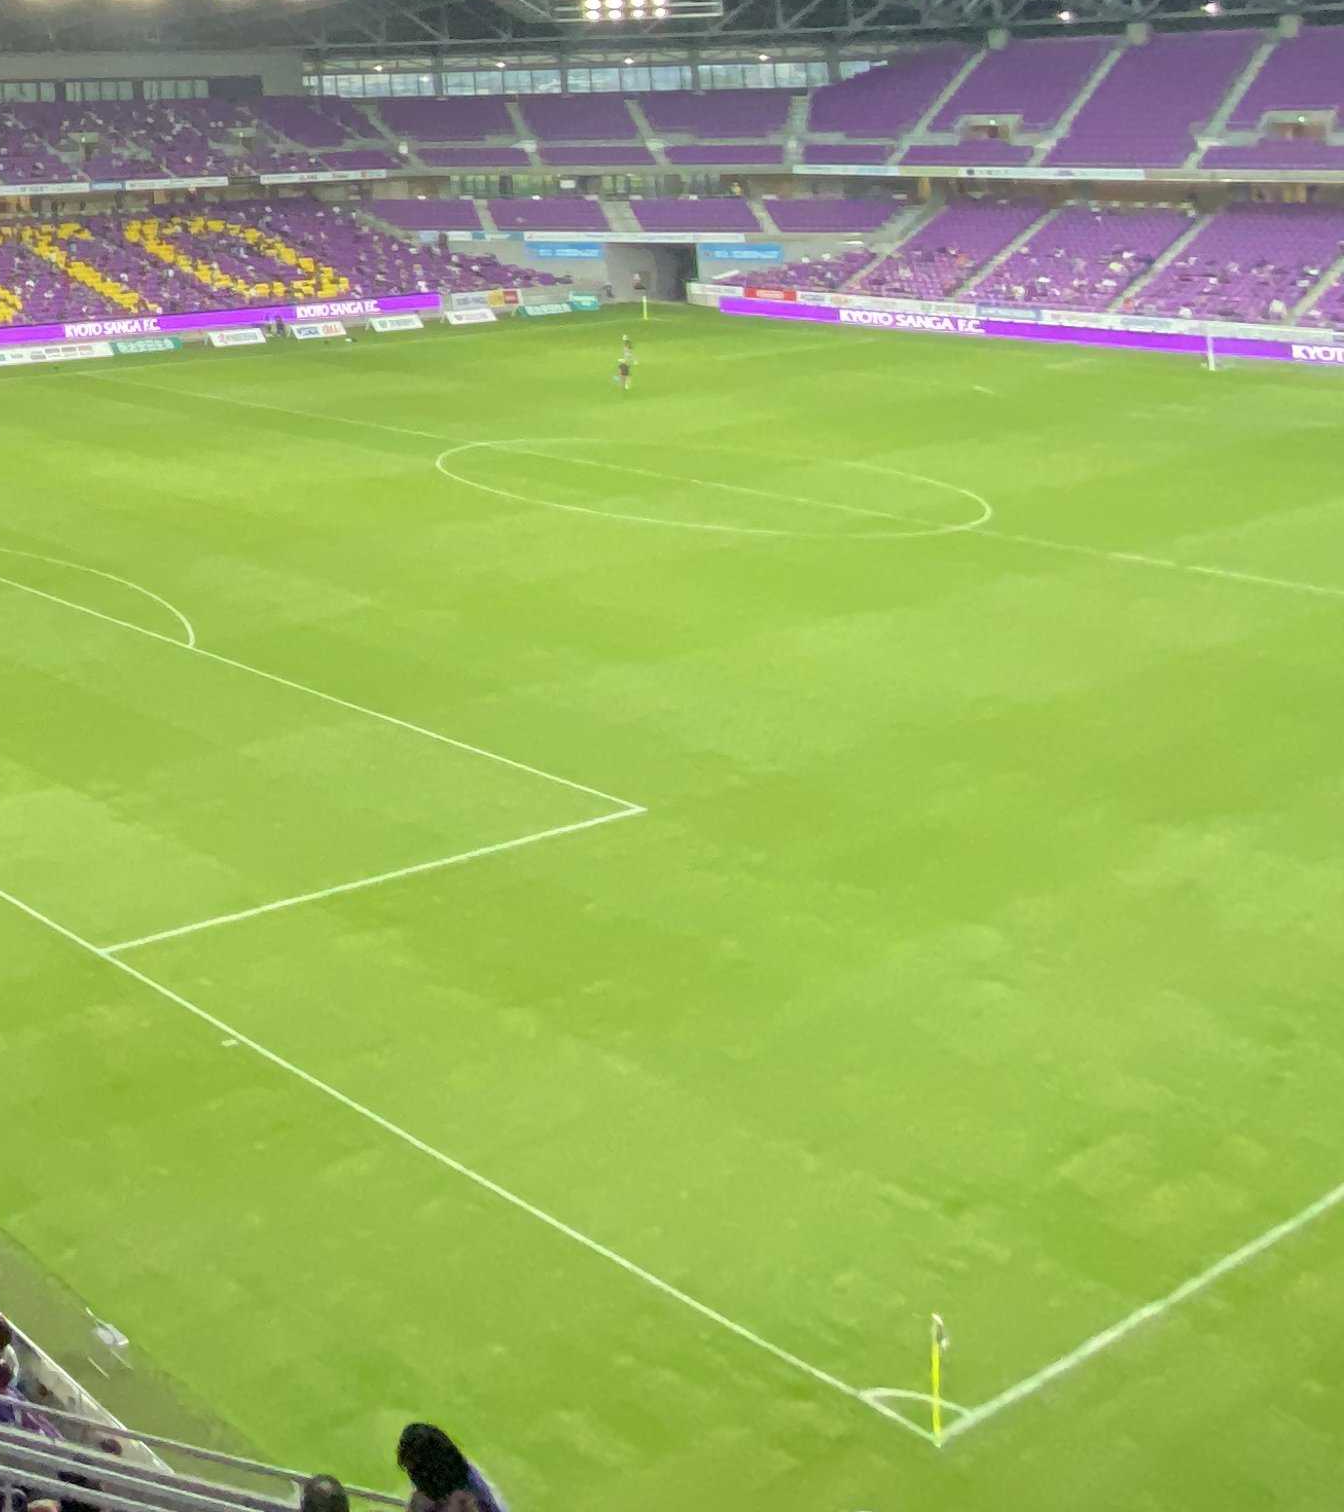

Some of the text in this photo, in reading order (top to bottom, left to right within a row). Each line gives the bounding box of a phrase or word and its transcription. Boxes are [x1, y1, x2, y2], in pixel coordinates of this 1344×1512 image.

[64, 321, 102, 338] KYOTO
[103, 318, 142, 335] SANGA
[839, 309, 894, 326] KYOTO
[895, 313, 955, 332] SANGA
